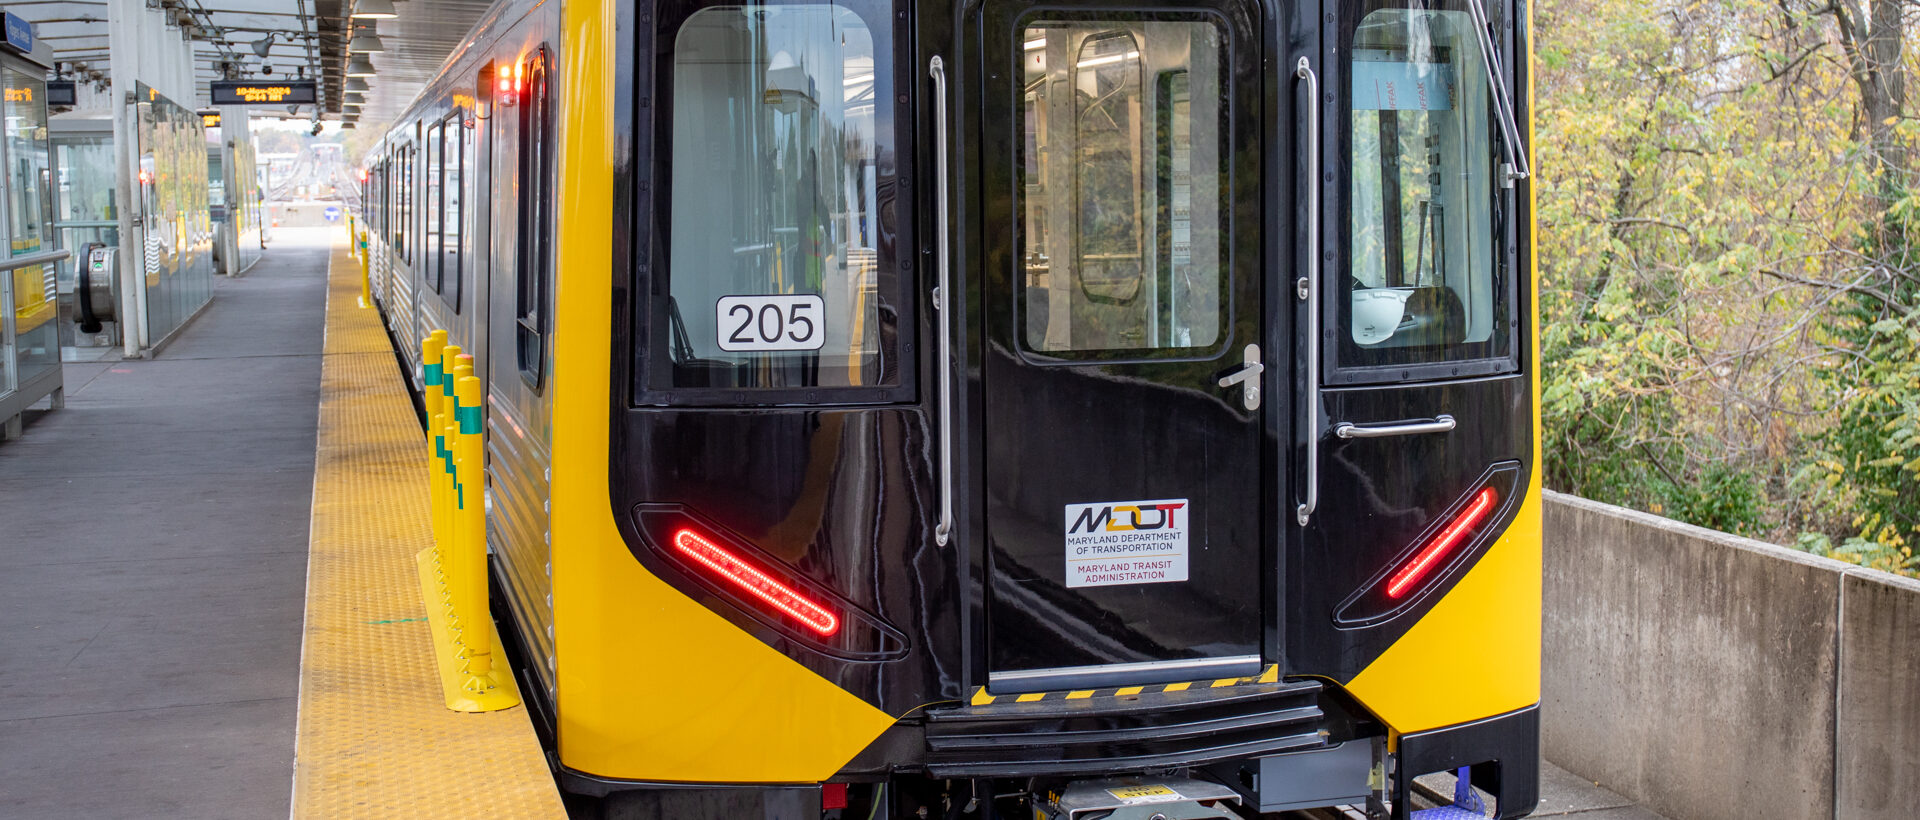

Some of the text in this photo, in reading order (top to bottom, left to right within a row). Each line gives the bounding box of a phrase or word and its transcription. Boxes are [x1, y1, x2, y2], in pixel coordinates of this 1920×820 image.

[728, 303, 814, 343] 205
[1068, 503, 1186, 534] MDOT
[1068, 532, 1182, 545] MARYLAND DEPARTMENT
[1076, 542, 1173, 555] OF TRANSPORTATION
[1078, 561, 1172, 574] MARYLAND TRANSIT
[1085, 571, 1165, 583] ADMINISTRATION
